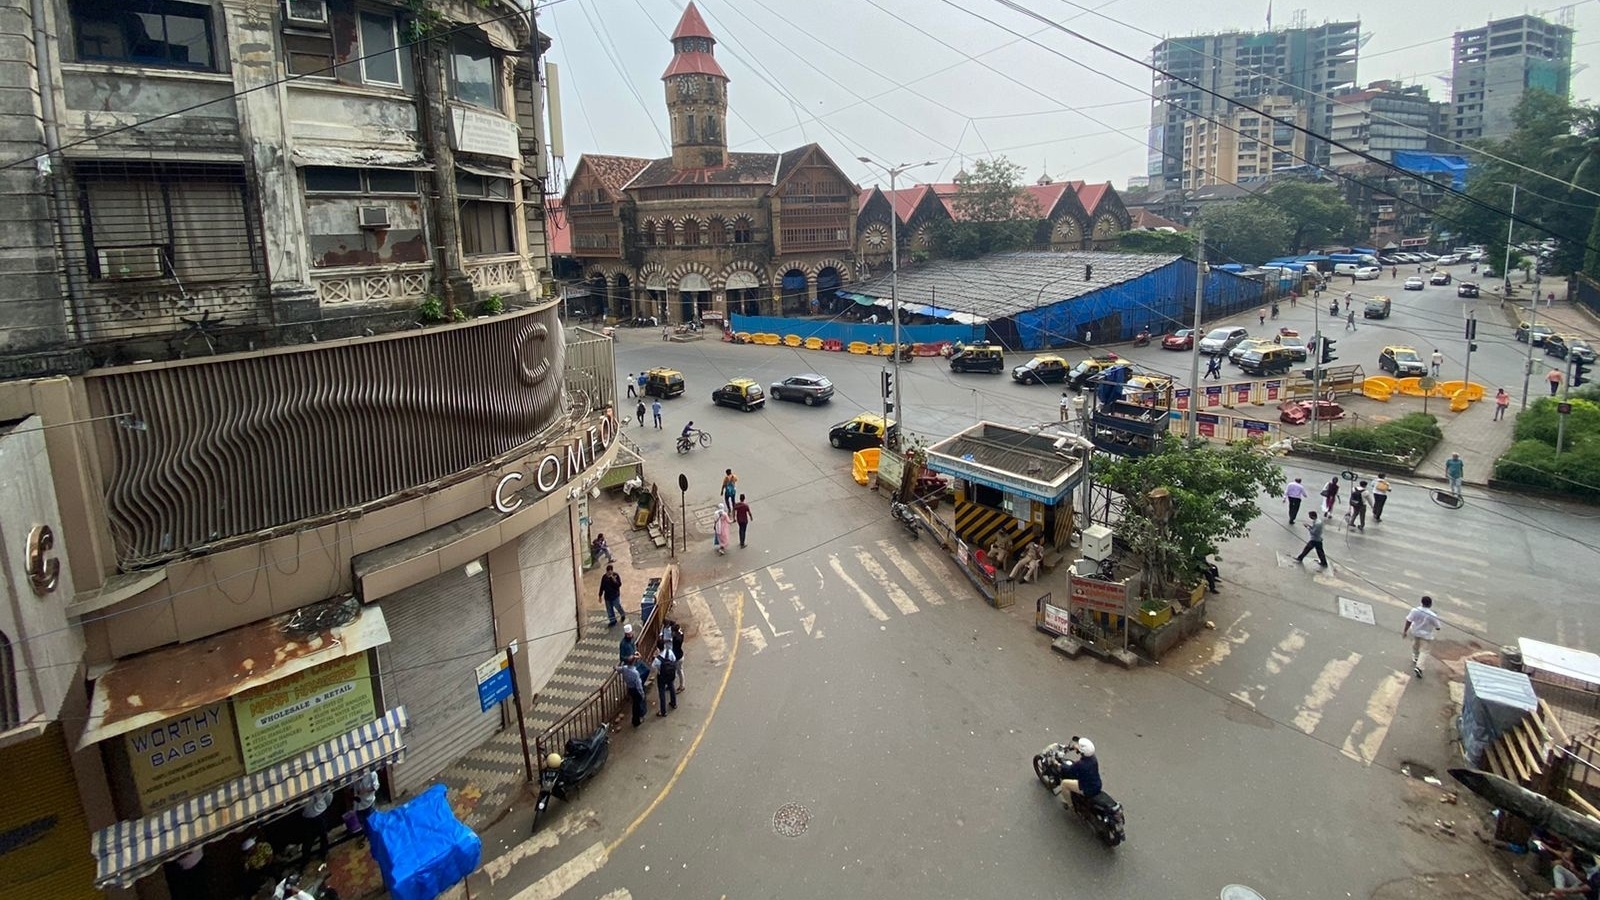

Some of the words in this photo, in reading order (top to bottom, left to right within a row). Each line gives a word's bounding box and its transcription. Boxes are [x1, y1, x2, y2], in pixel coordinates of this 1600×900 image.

[260, 700, 310, 725] WHOLESALE
[324, 684, 352, 700] RETAIL
[131, 707, 220, 753] WORTHY
[150, 733, 213, 767] BAGS
